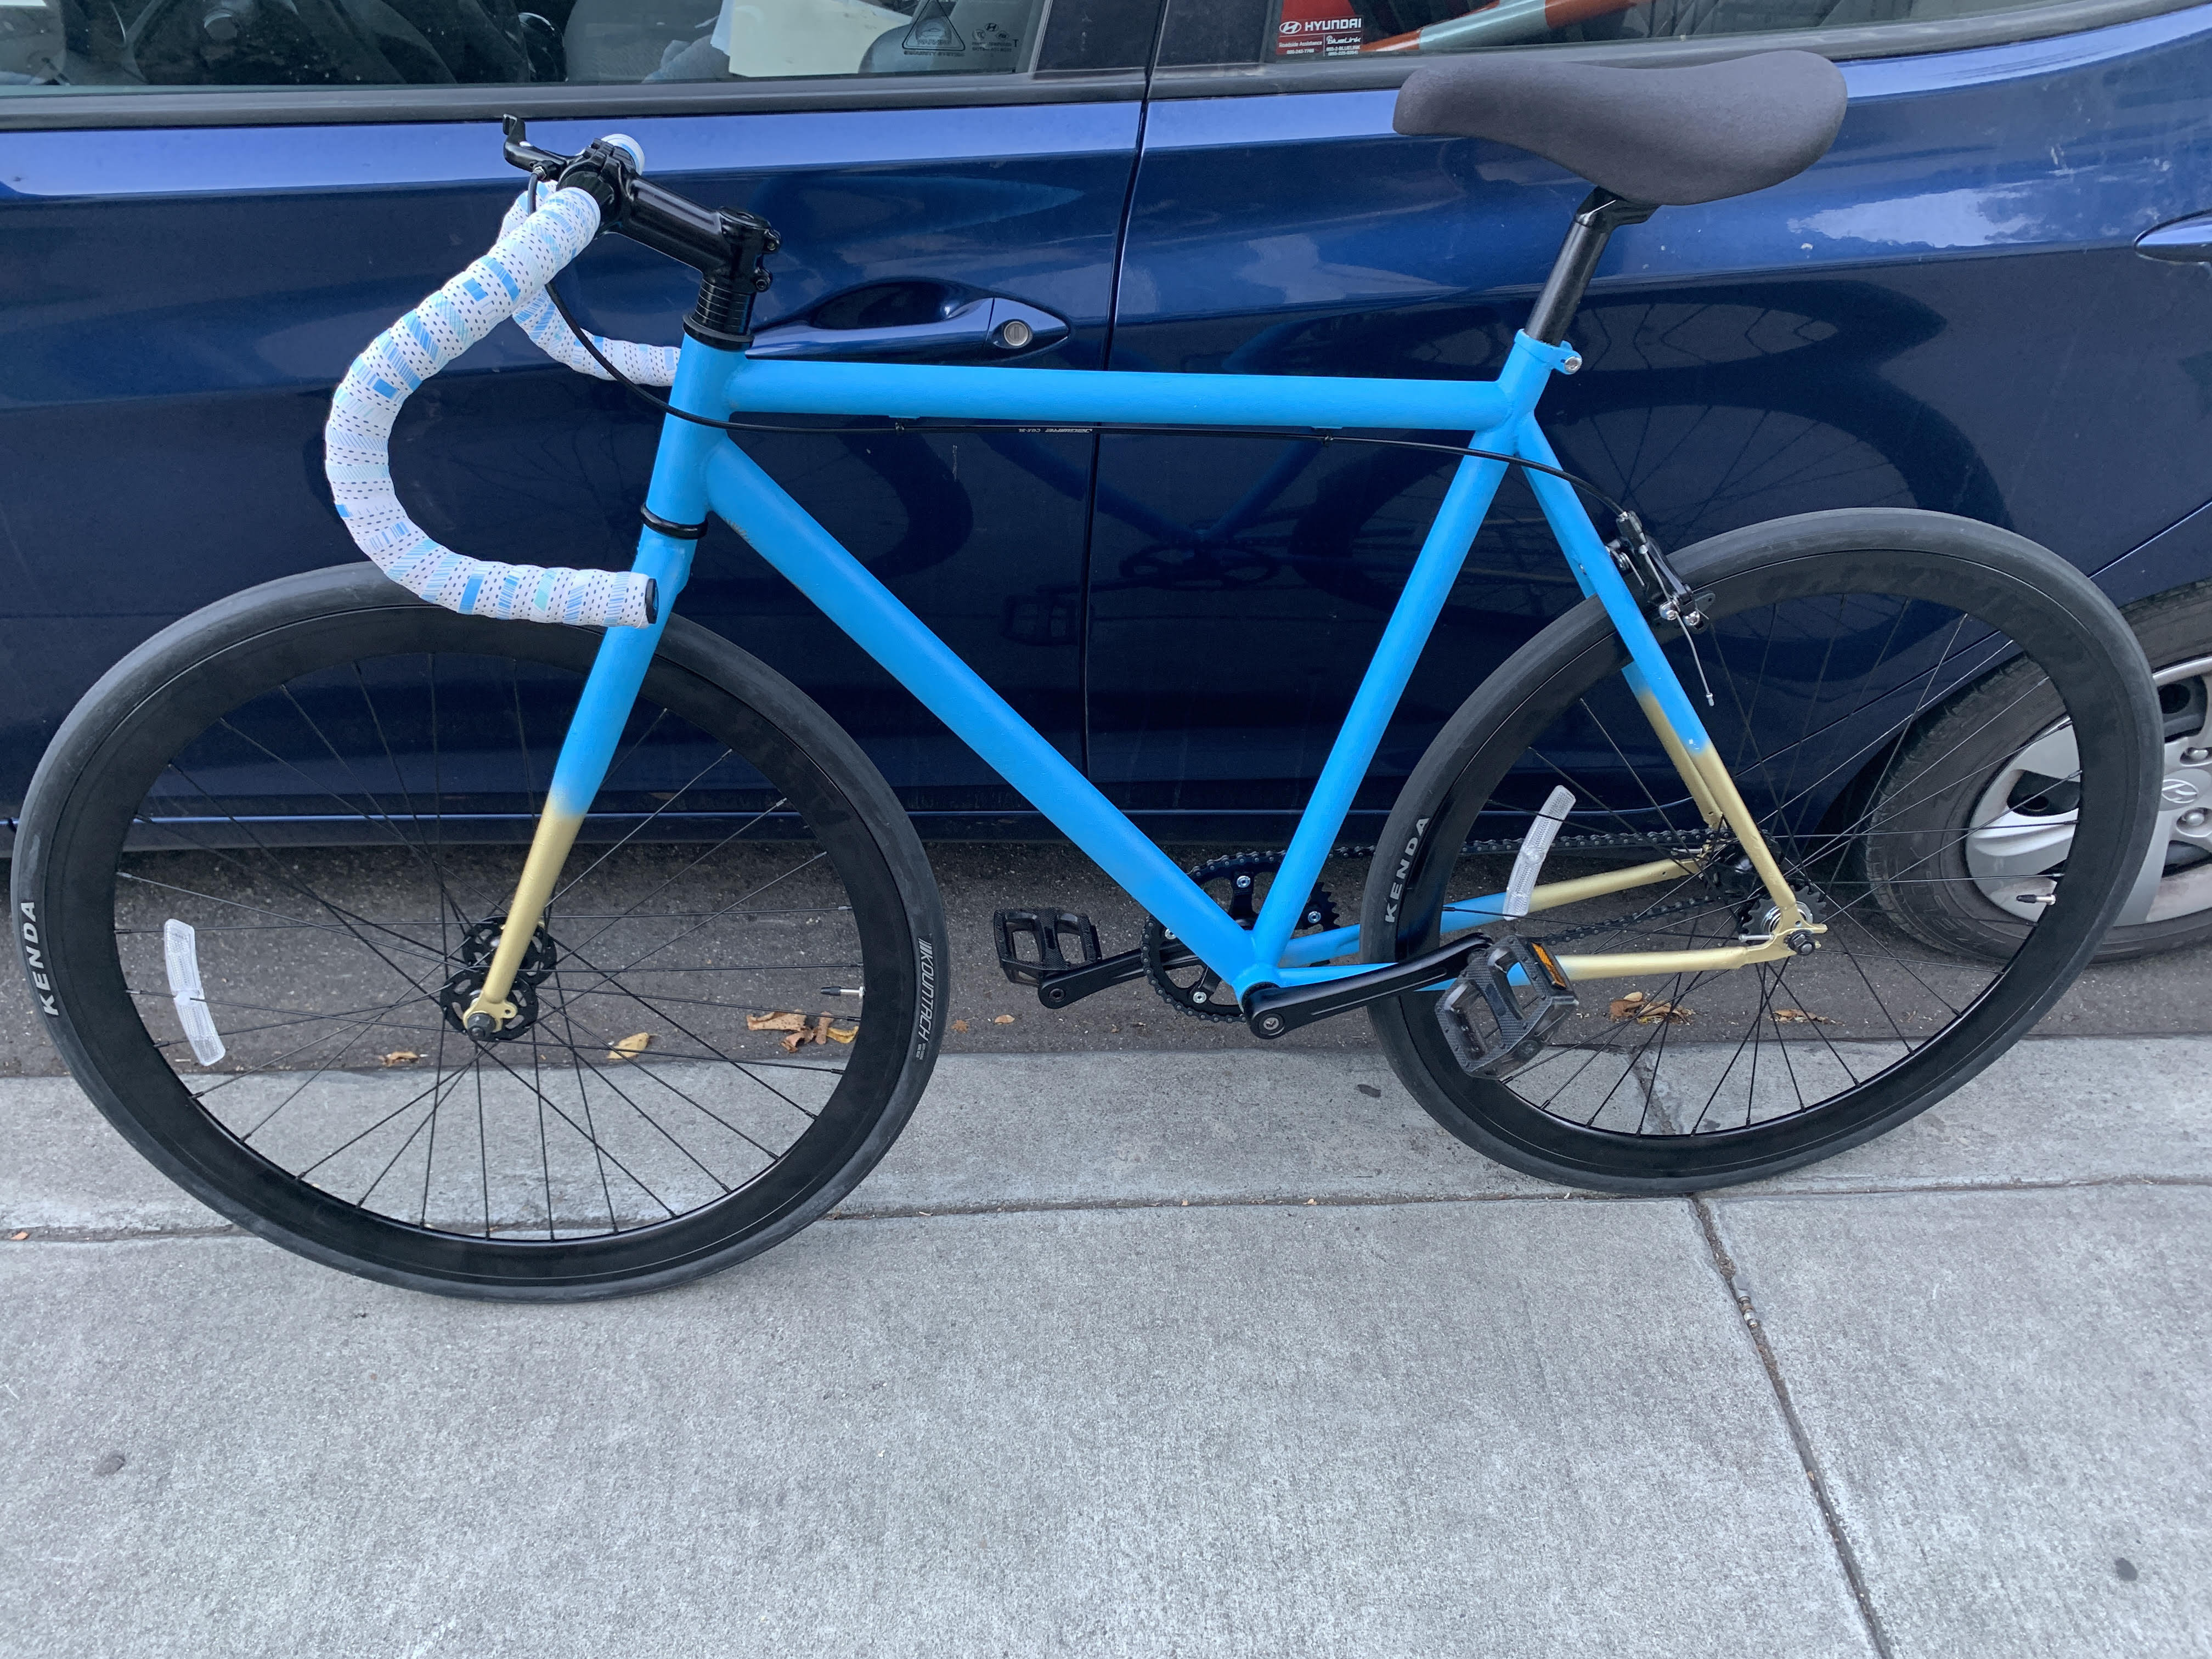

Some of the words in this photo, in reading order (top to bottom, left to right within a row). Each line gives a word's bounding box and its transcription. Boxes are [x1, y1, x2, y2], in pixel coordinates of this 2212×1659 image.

[1305, 18, 1362, 31] HYUNDAI
[1385, 817, 1430, 923] KENDA
[20, 901, 59, 1016] KENDA
[918, 945, 934, 1042] KOUNTACH
